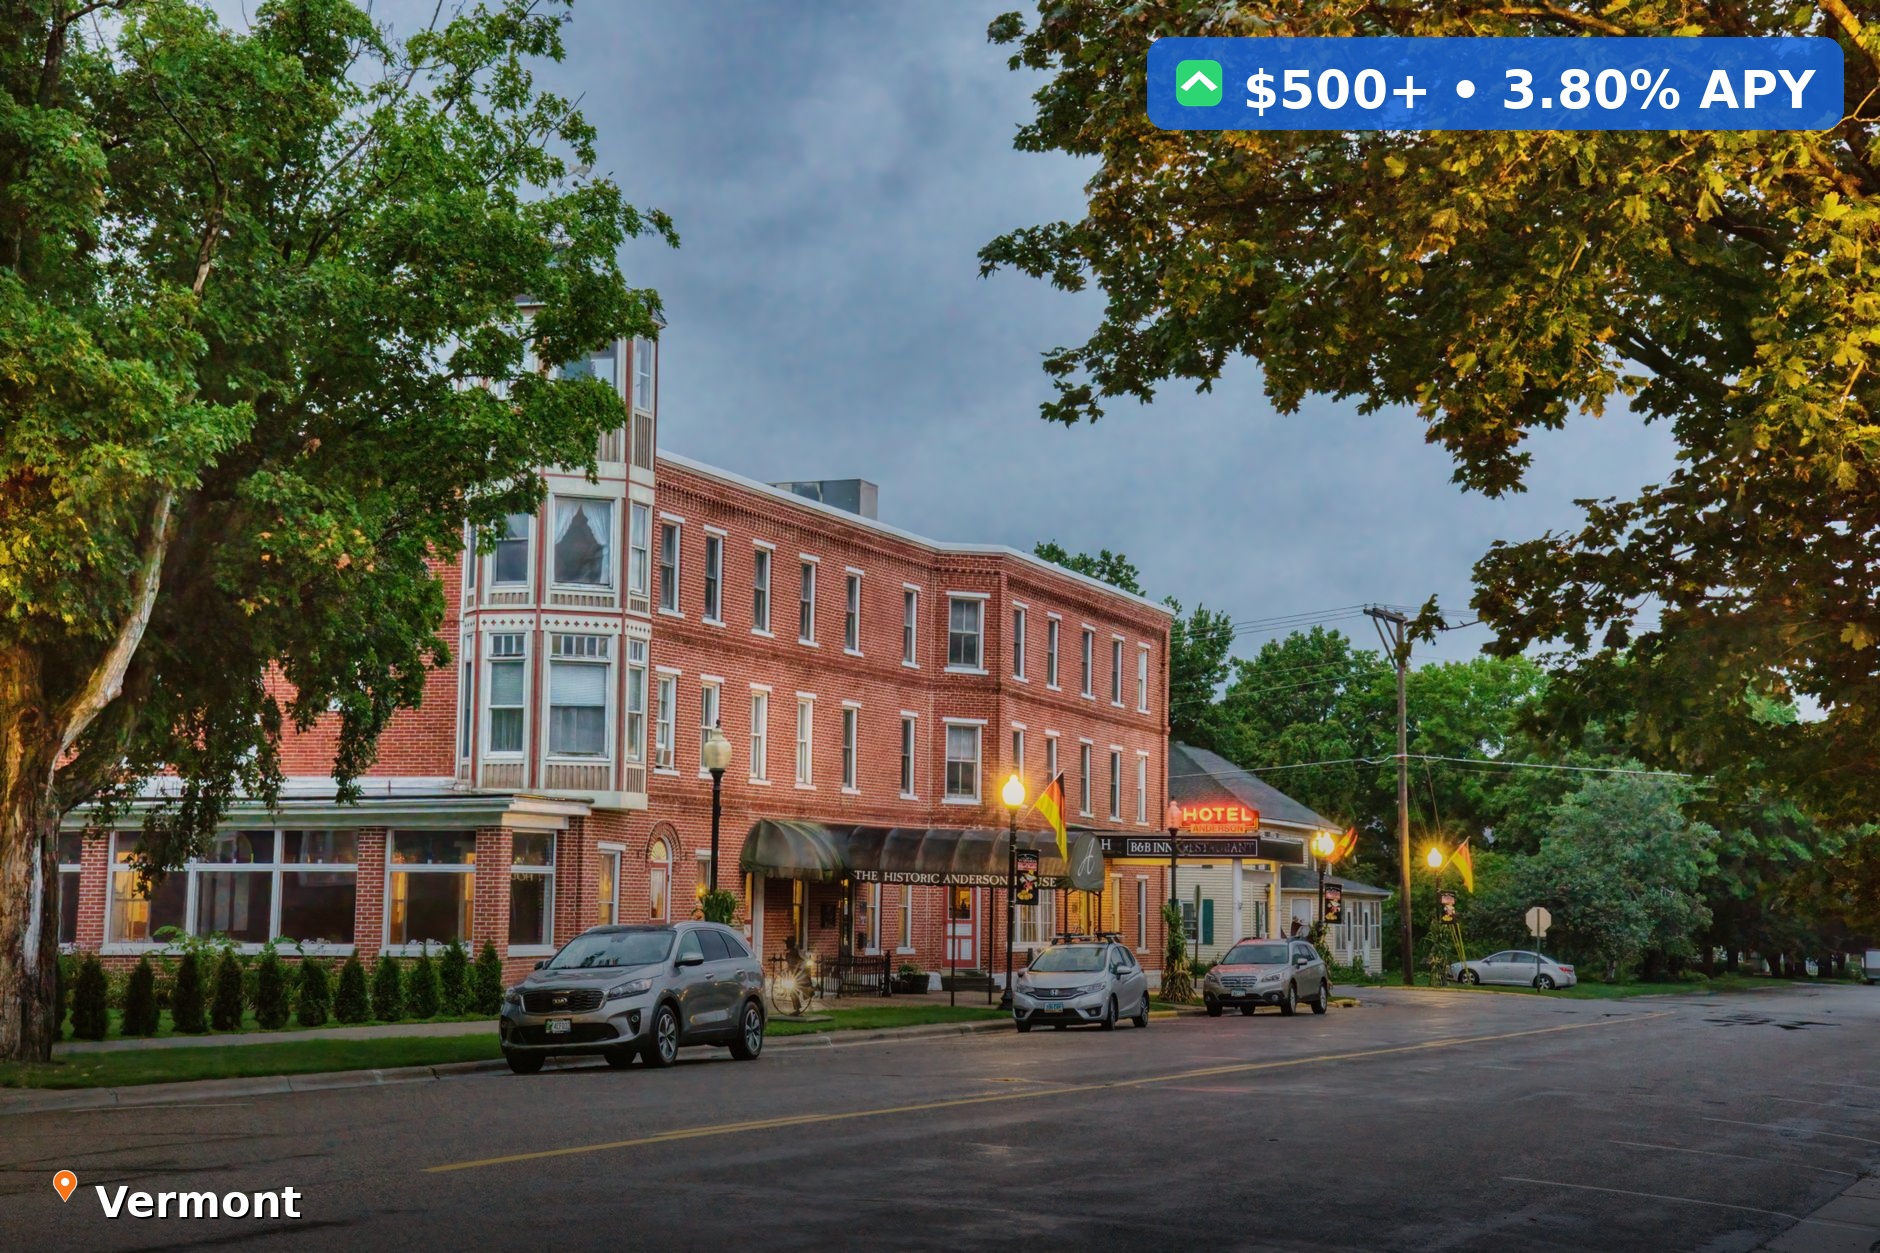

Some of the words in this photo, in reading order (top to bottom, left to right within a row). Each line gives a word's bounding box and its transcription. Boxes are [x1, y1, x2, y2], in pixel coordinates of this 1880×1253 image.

[1183, 807, 1252, 822] HOTEL
[1192, 824, 1245, 833] ANDERSON
[1130, 841, 1151, 853] B&B
[1153, 841, 1173, 853] INN
[1180, 842, 1256, 854] ESTRANT
[854, 869, 879, 881] THE
[884, 872, 940, 884] HISTORIC
[943, 873, 1009, 886] ANDERSON
